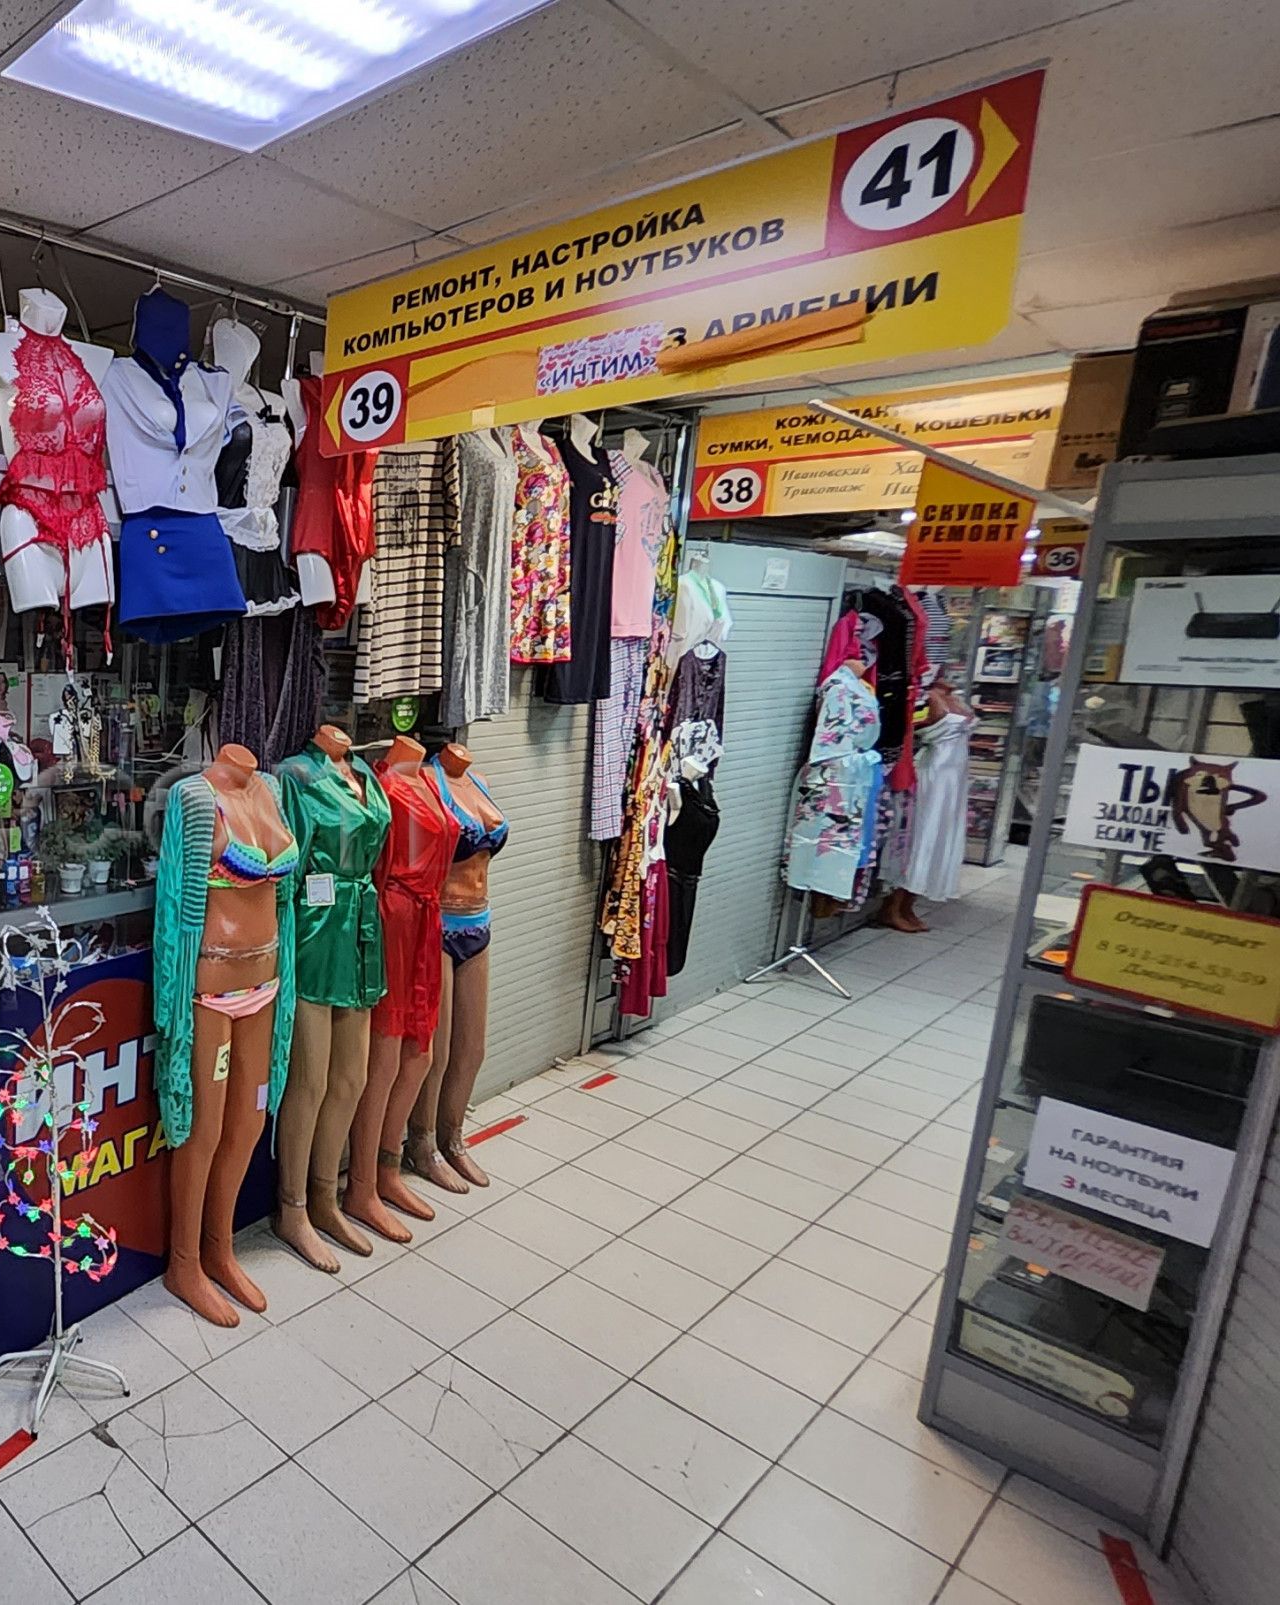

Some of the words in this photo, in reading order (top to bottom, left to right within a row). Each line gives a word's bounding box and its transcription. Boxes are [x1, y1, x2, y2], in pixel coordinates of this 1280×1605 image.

[859, 128, 959, 211] 41
[391, 264, 503, 315] РЕМОНТ,
[509, 203, 707, 281] НАСТРОЙКА
[341, 281, 536, 358] КОМПЬЮТЕРОВ
[543, 276, 565, 303] И
[574, 217, 787, 294] НОУТБУКОВ
[539, 350, 657, 390] «ИНТИМ»
[348, 381, 395, 429] 39
[706, 437, 774, 456] СУМКИ,
[780, 423, 907, 447] ЧЕМОДАЫ,
[914, 407, 1053, 434] КОШЕЛЬКИ
[715, 477, 754, 504] 38
[780, 464, 872, 482] Ивановский
[783, 482, 865, 500] Трикотаж
[923, 501, 1020, 522] СКУПКА
[917, 523, 1020, 543] РЕМОНТ
[1048, 551, 1076, 568] 36
[1095, 825, 1136, 844] ЕСЛИ
[1071, 1128, 1185, 1171] ГАРАНТИЯ
[1048, 1145, 1078, 1165] НА
[1080, 1155, 1200, 1202] НОУТБУКИ
[1060, 1174, 1077, 1190] 3
[1079, 1182, 1173, 1224] МЕСЯЦА
